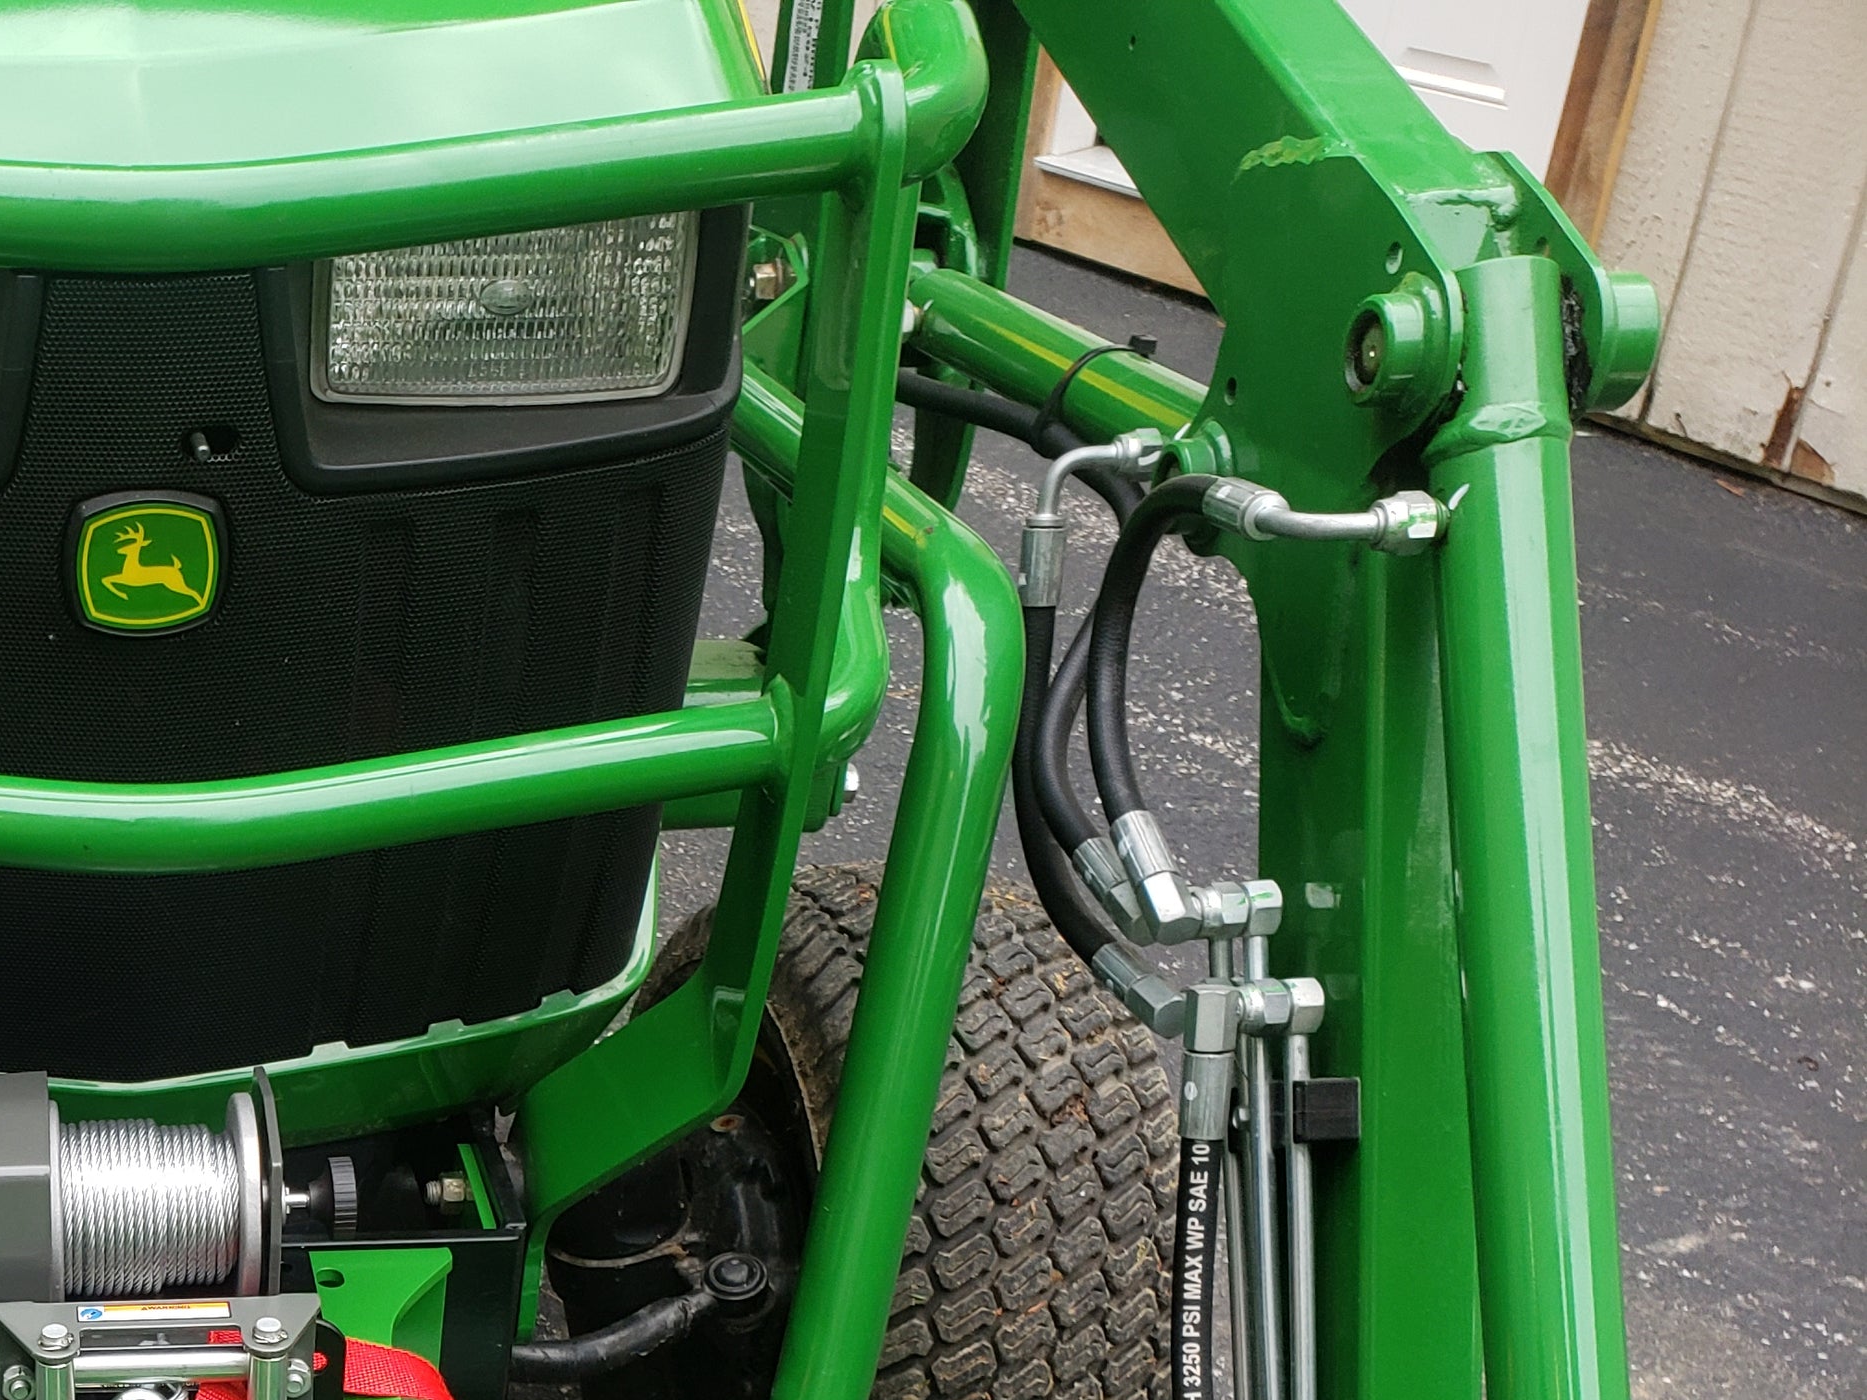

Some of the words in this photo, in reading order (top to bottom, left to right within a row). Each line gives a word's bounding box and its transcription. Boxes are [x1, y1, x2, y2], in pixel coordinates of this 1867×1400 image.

[1188, 1170, 1209, 1212] SAE
[1185, 1217, 1205, 1250] WP
[1183, 1253, 1203, 1300] MAX
[1182, 1304, 1201, 1338] PSI
[1182, 1342, 1201, 1387] 3250
